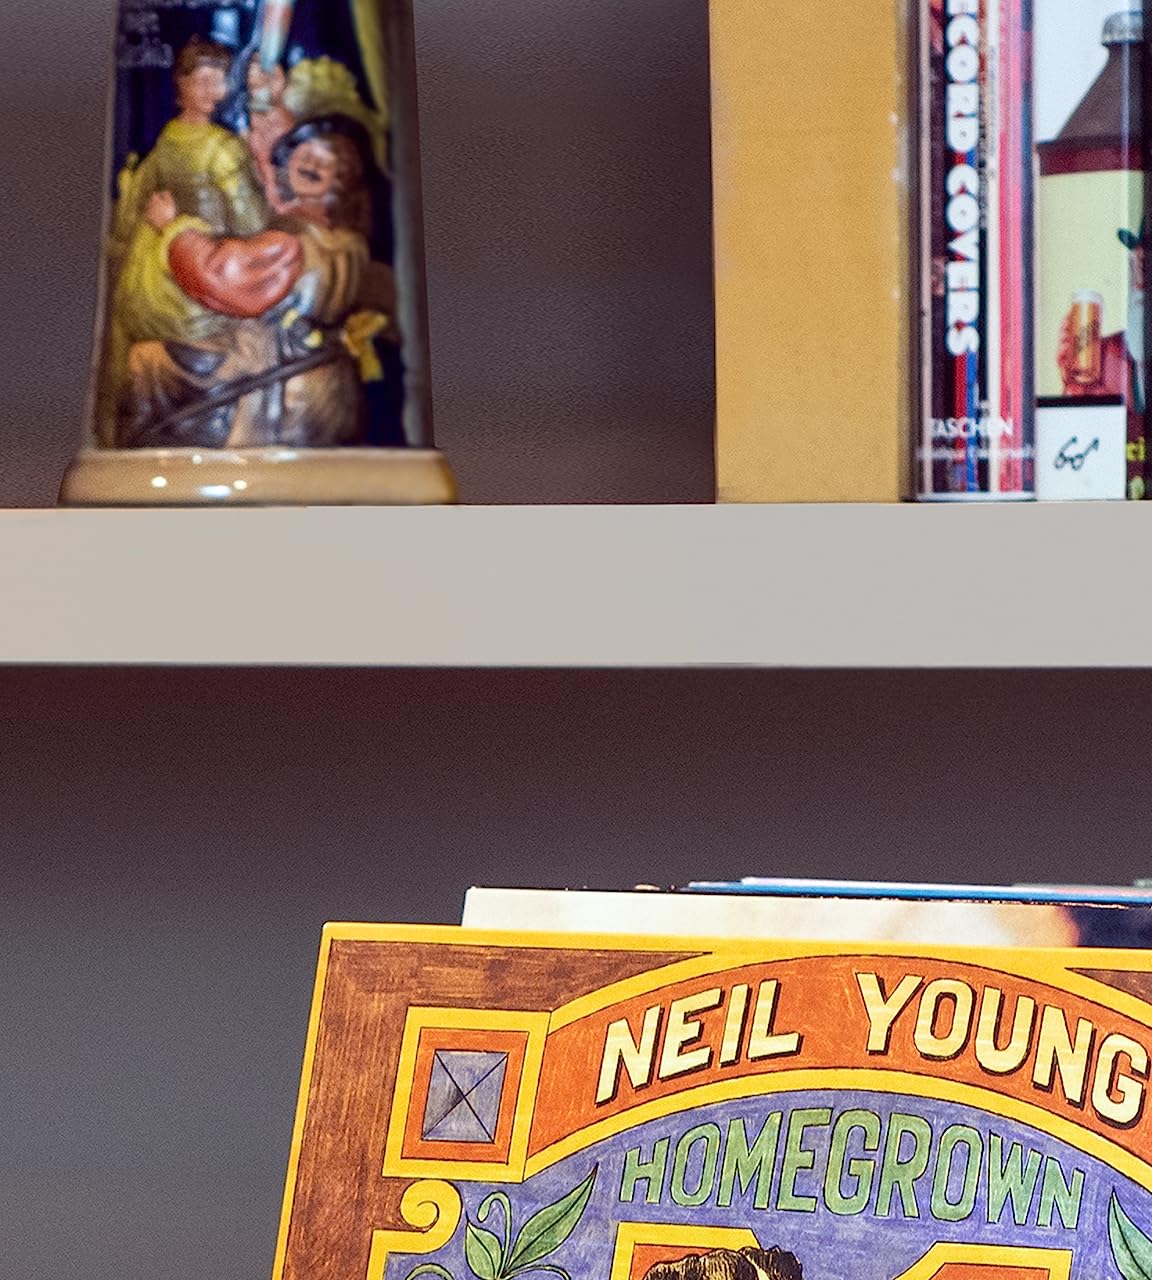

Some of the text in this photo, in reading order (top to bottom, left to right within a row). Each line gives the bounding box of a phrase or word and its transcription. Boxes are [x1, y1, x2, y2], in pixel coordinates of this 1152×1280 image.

[945, 164, 979, 356] COVERS
[595, 971, 1152, 1131] NEIL YOUNG
[618, 1106, 1086, 1231] HOMEGROWN
